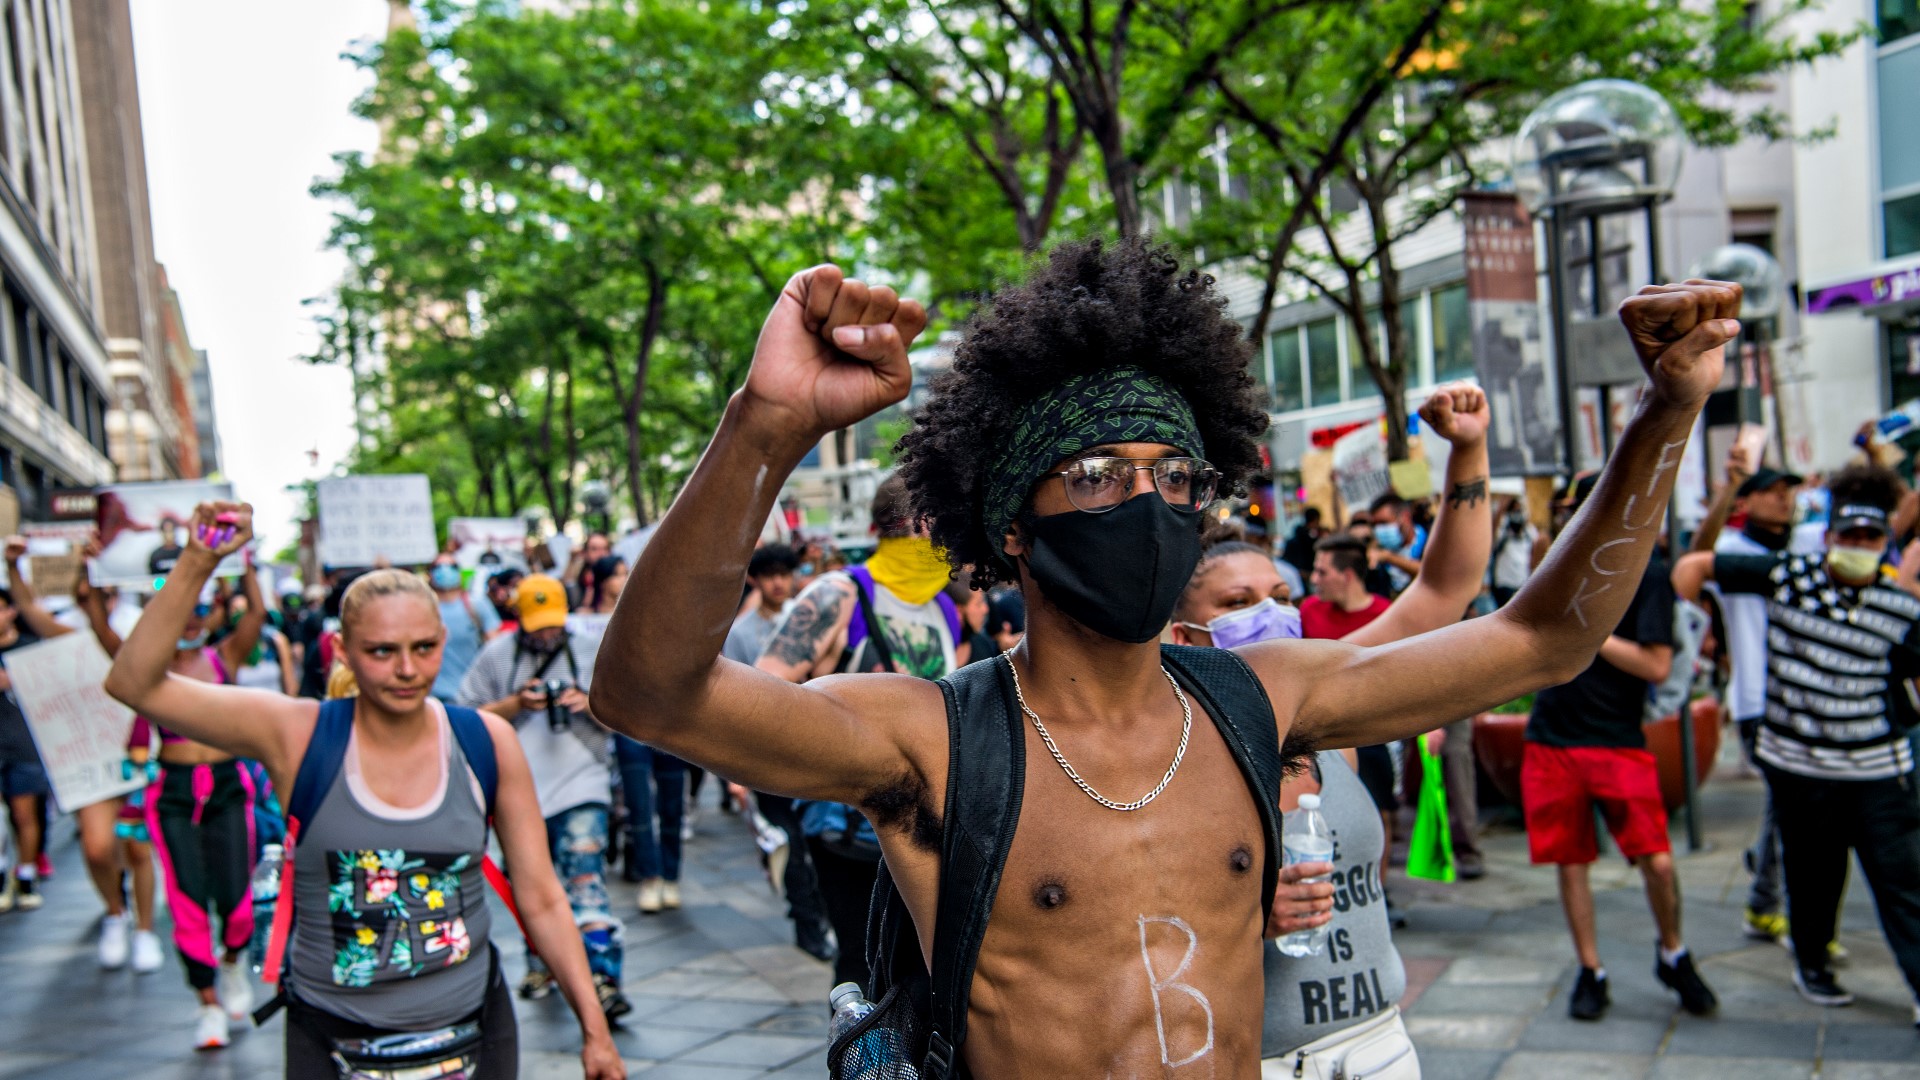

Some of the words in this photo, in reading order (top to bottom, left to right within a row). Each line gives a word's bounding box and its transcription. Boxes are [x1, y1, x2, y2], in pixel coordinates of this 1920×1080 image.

[1564, 438, 1688, 629] FUCK
[1137, 913, 1215, 1068] B
[1299, 968, 1389, 1026] REAL
[1328, 928, 1354, 963] IS
